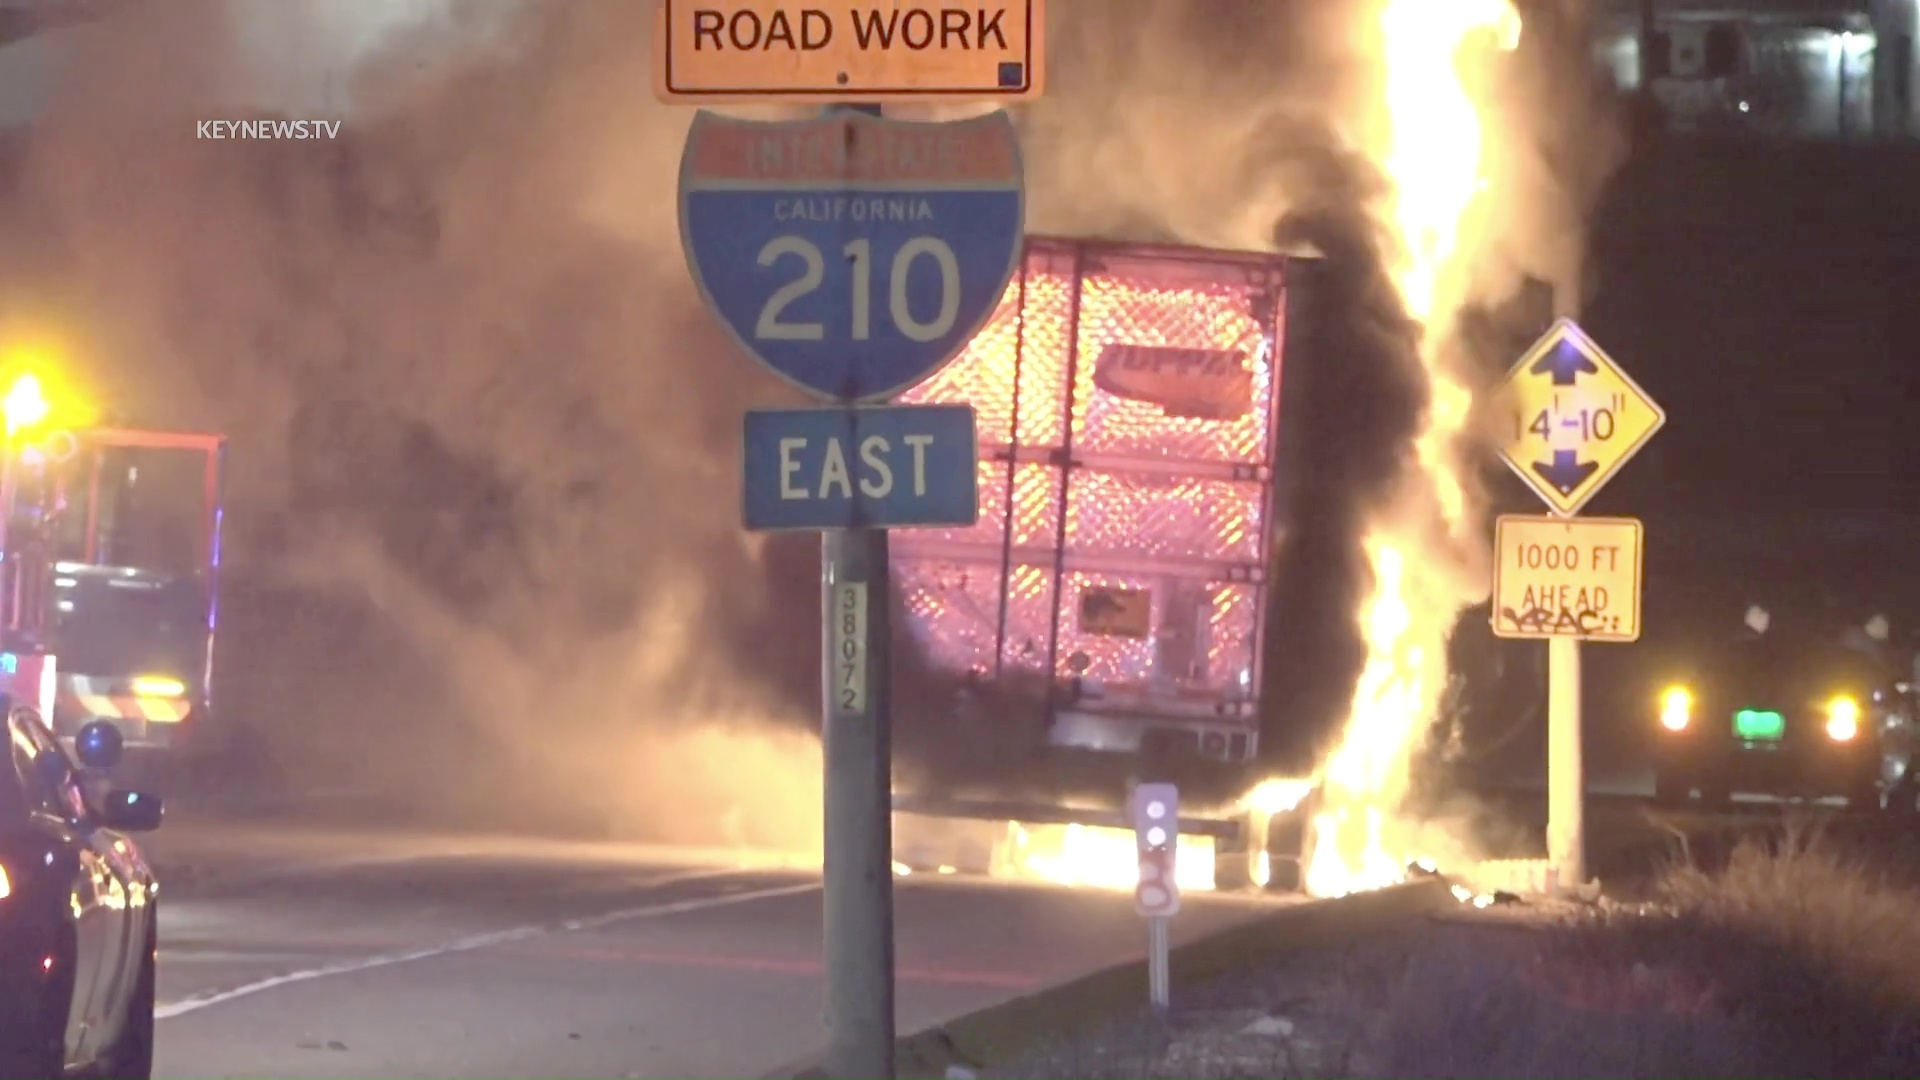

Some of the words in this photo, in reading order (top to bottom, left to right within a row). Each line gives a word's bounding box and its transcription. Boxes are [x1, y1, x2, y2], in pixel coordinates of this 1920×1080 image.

[693, 8, 833, 51] ROAD
[850, 8, 1009, 51] WORK
[773, 199, 934, 221] CALIFORNIA
[755, 235, 961, 343] 210
[779, 434, 935, 500] EAST
[1516, 544, 1579, 571] 1000
[1591, 545, 1621, 573] FT
[1521, 583, 1609, 612] AHEAD
[841, 588, 857, 710] 38072
